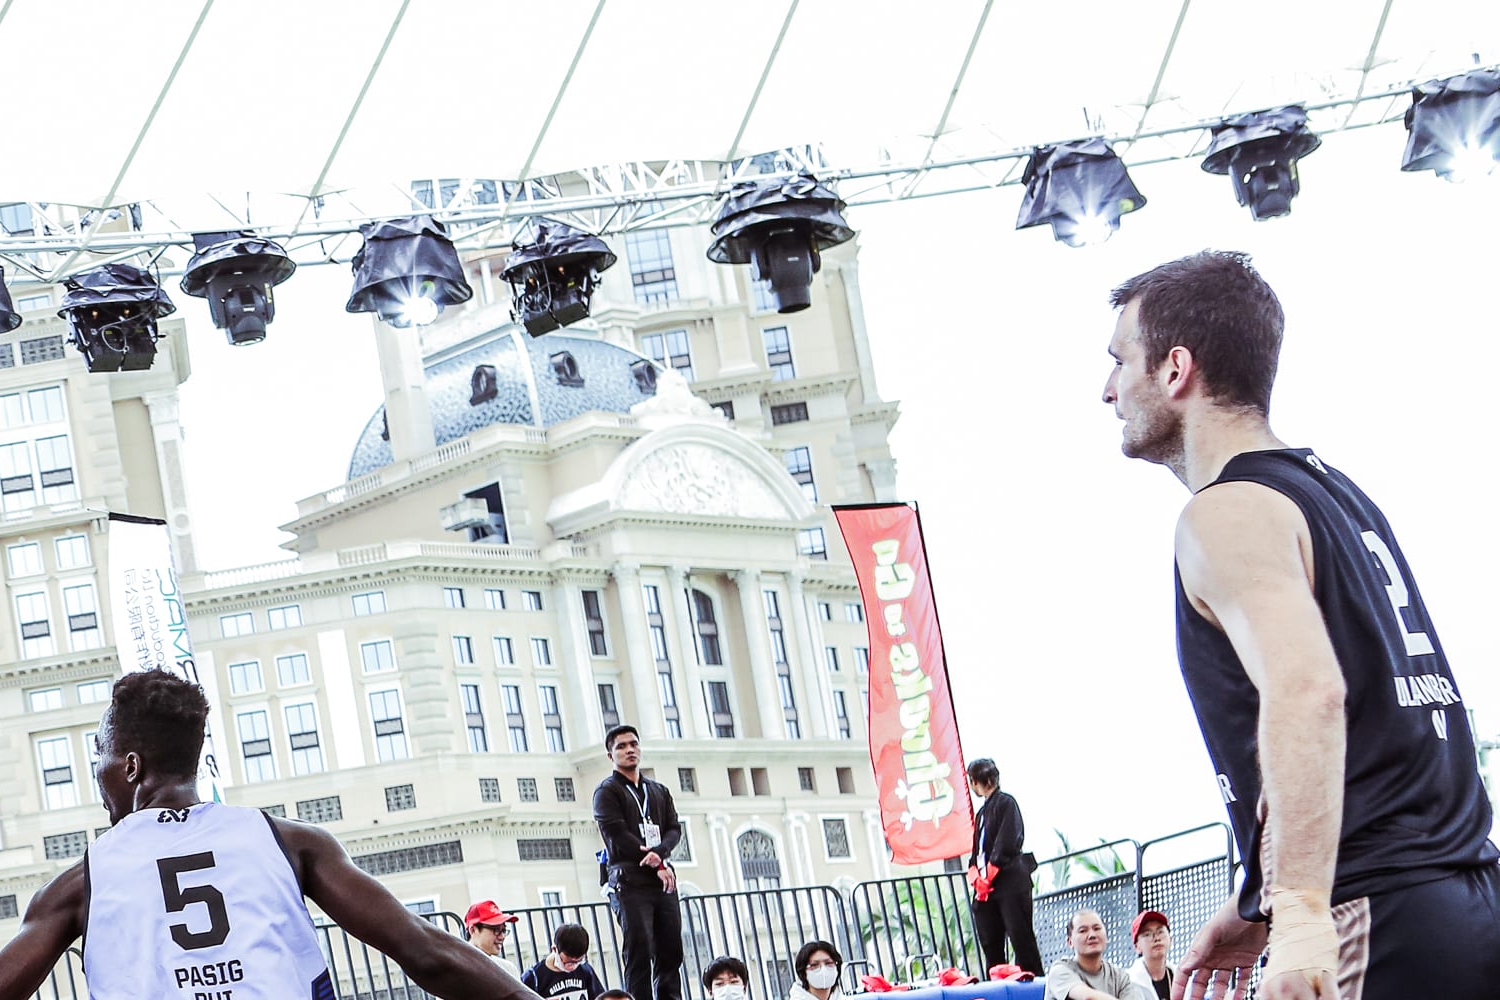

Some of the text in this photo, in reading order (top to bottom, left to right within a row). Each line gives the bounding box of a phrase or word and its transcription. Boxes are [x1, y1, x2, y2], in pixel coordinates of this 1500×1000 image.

[1360, 530, 1436, 657] 2
[156, 850, 231, 951] 5
[174, 959, 244, 989] PASIG
